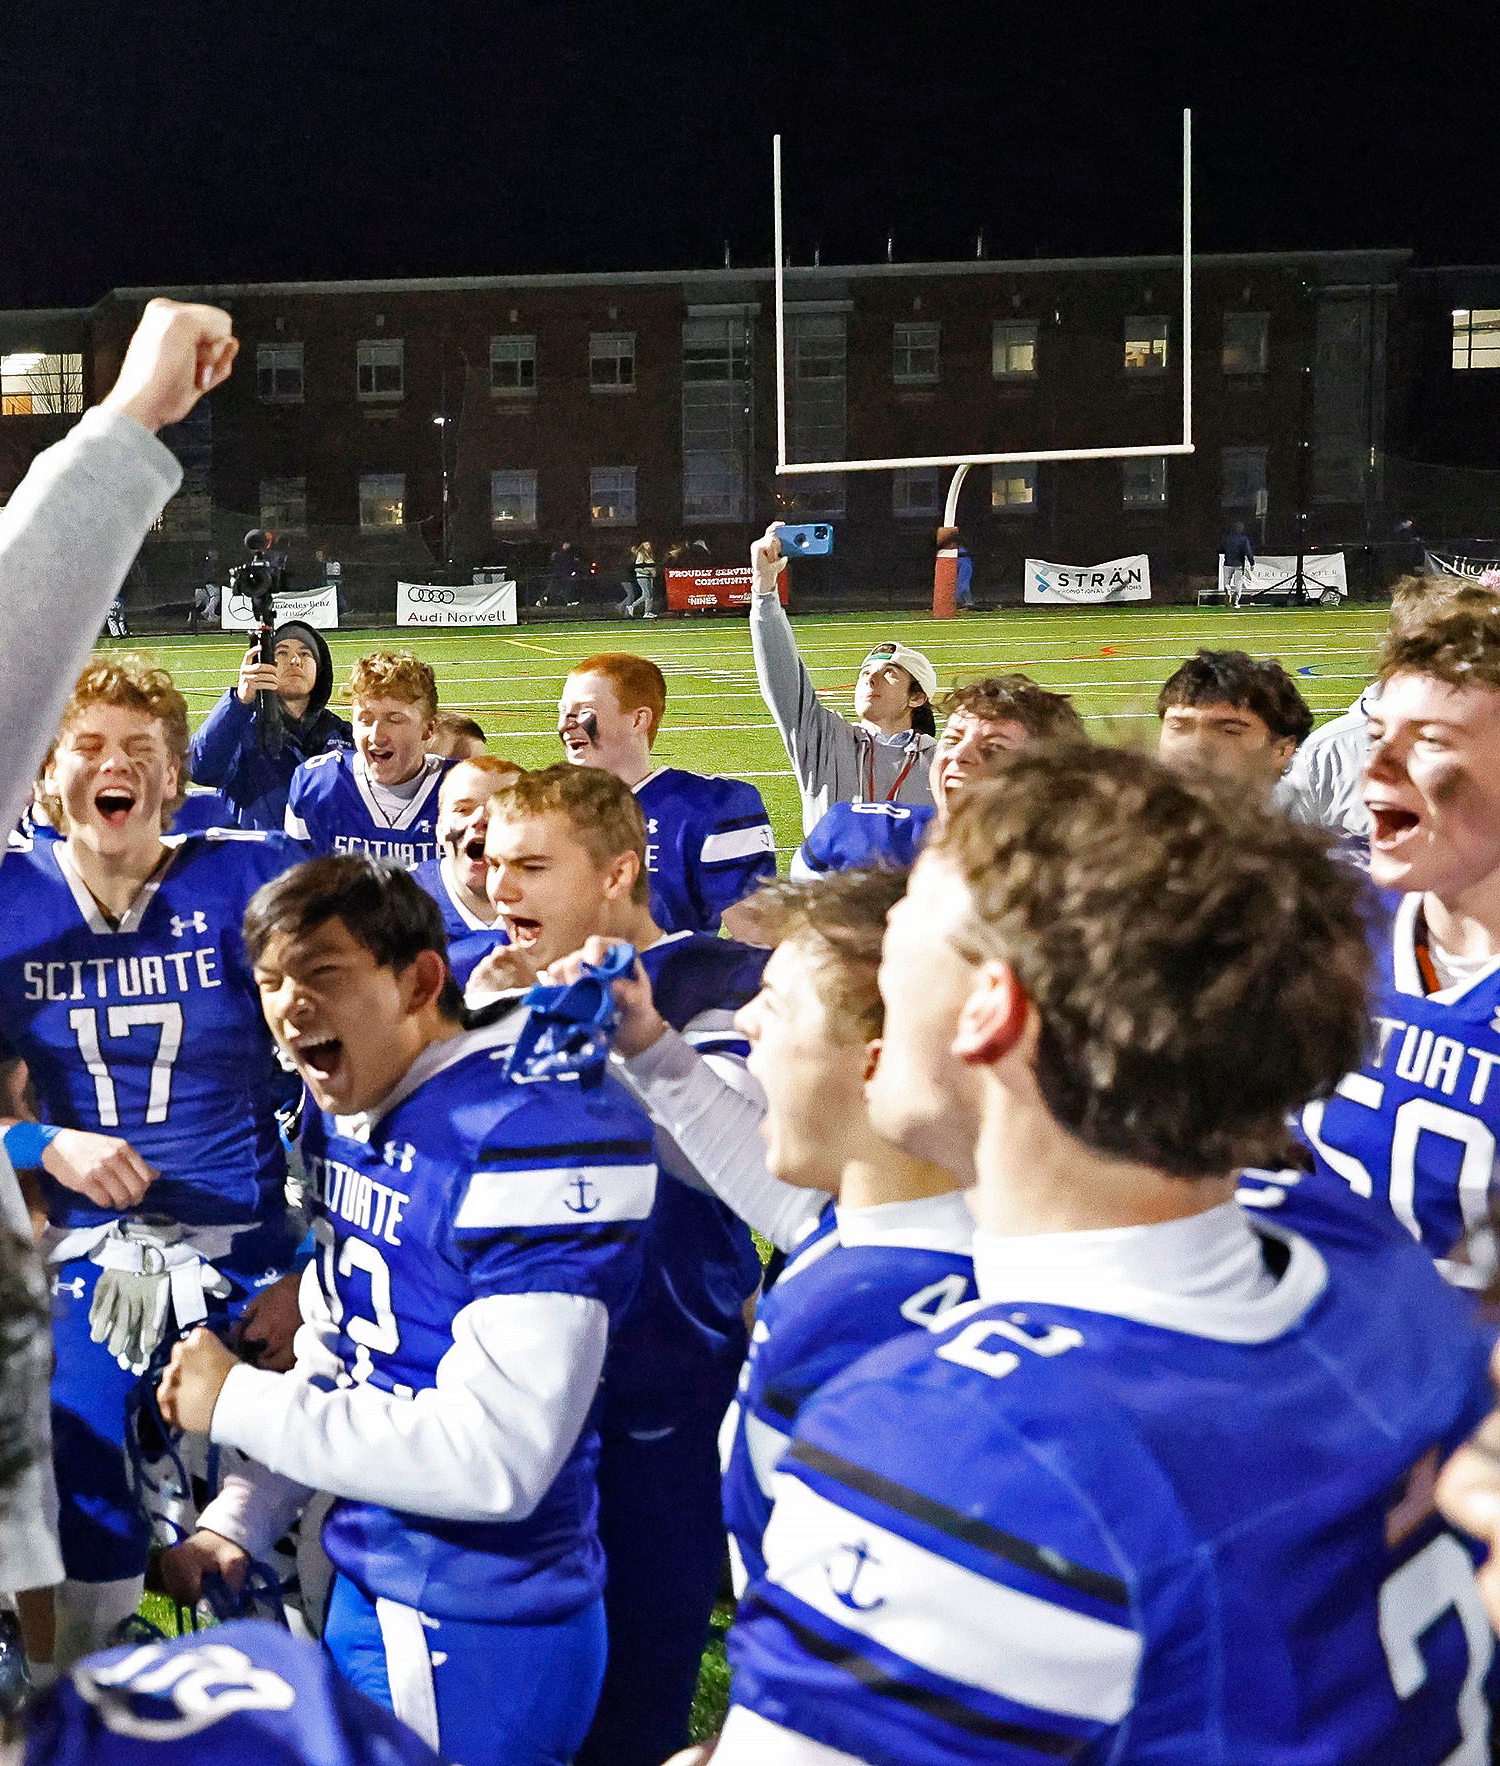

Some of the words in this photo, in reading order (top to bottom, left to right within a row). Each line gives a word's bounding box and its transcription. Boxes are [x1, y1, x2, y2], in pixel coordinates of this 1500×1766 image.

[668, 570, 713, 578] PROUDLY
[1057, 567, 1142, 588] STRÄN
[407, 611, 443, 623] Audi
[447, 610, 506, 623] Norwell
[23, 947, 222, 1001] SCITUATE
[69, 1001, 184, 1127] 17
